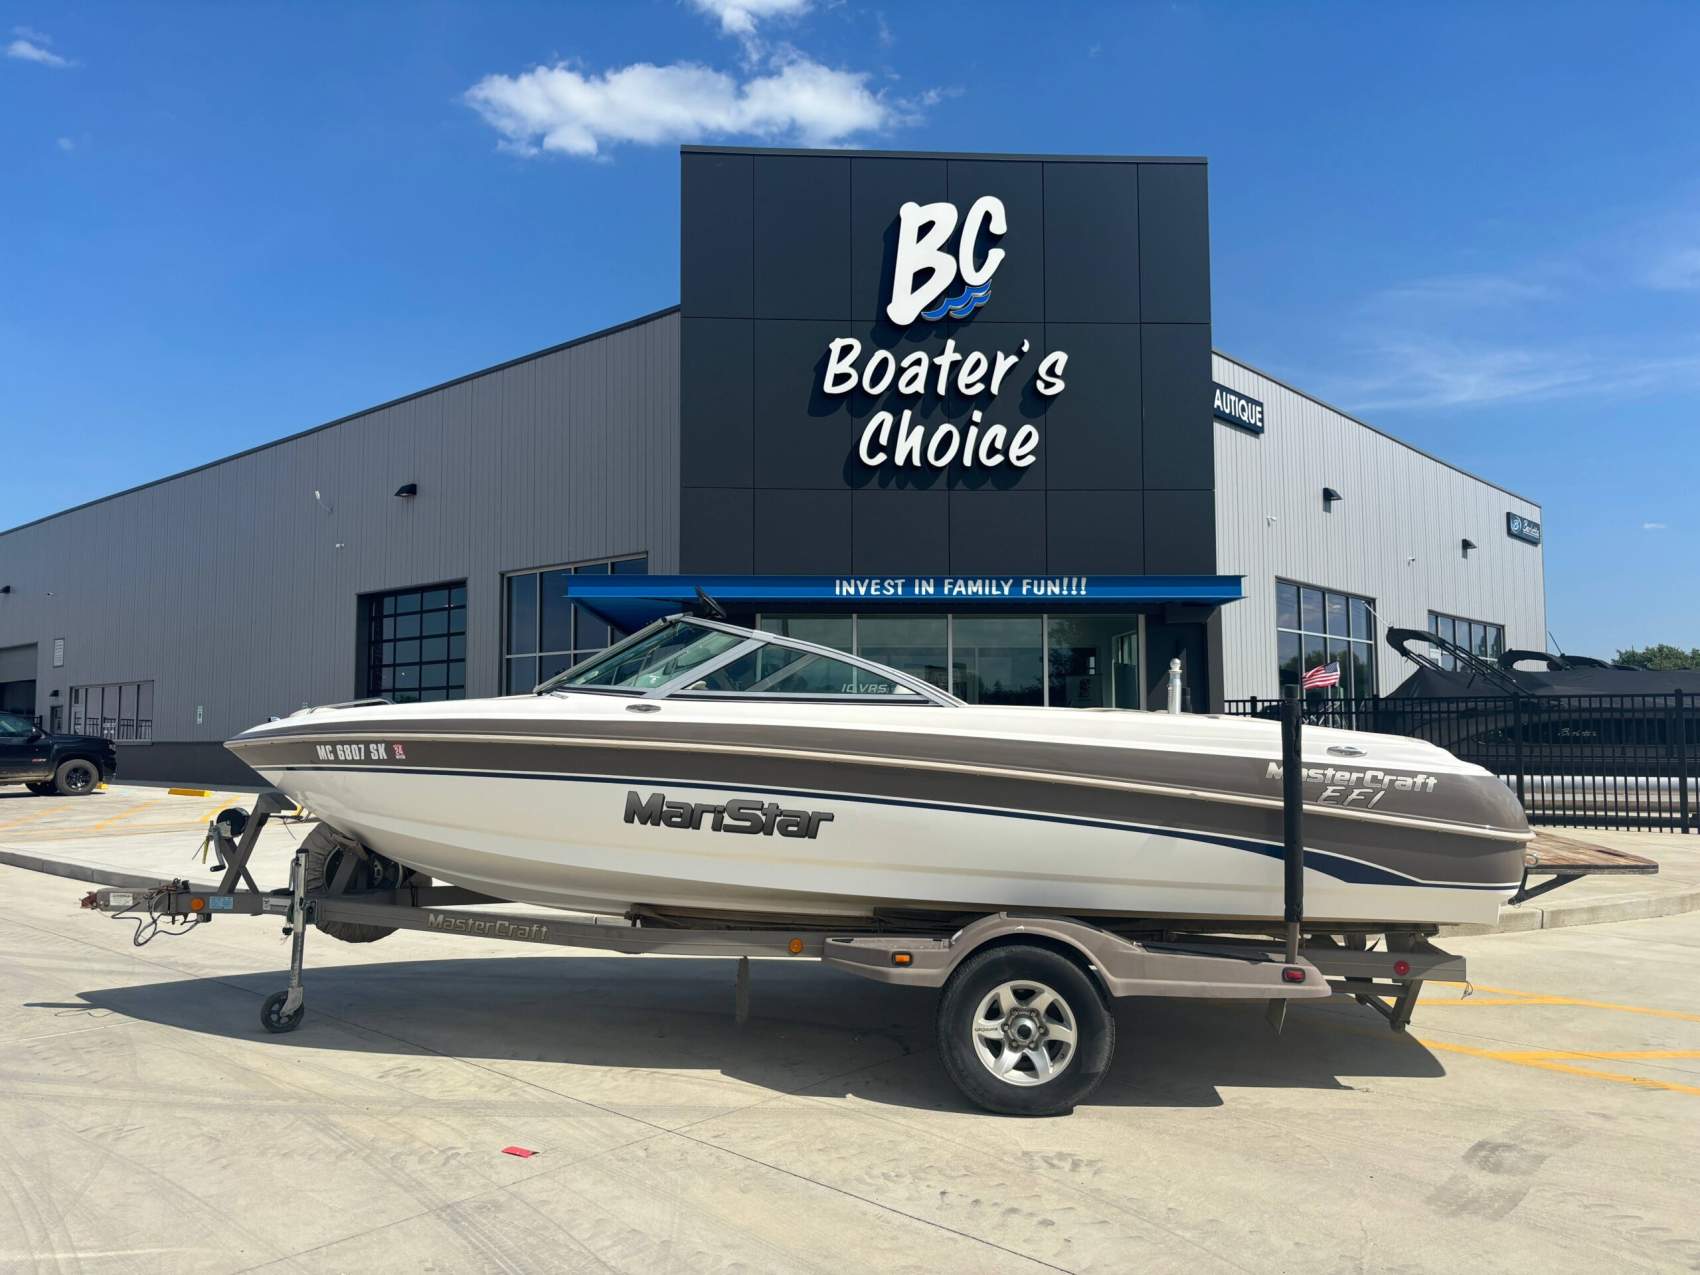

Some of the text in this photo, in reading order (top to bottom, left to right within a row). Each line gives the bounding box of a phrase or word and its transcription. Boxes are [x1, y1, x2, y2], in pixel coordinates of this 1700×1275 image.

[886, 195, 1008, 326] BC
[1213, 388, 1263, 428] AUTIQUE
[858, 409, 1040, 468] Choice
[835, 577, 1088, 596] INVEST IN FAMILY FUN!!!
[859, 683, 888, 694] VRS
[316, 743, 388, 761] MC 6807 SK
[1316, 785, 1386, 809] EFI
[623, 790, 835, 840] MariStar
[427, 912, 549, 940] MasterCraft
